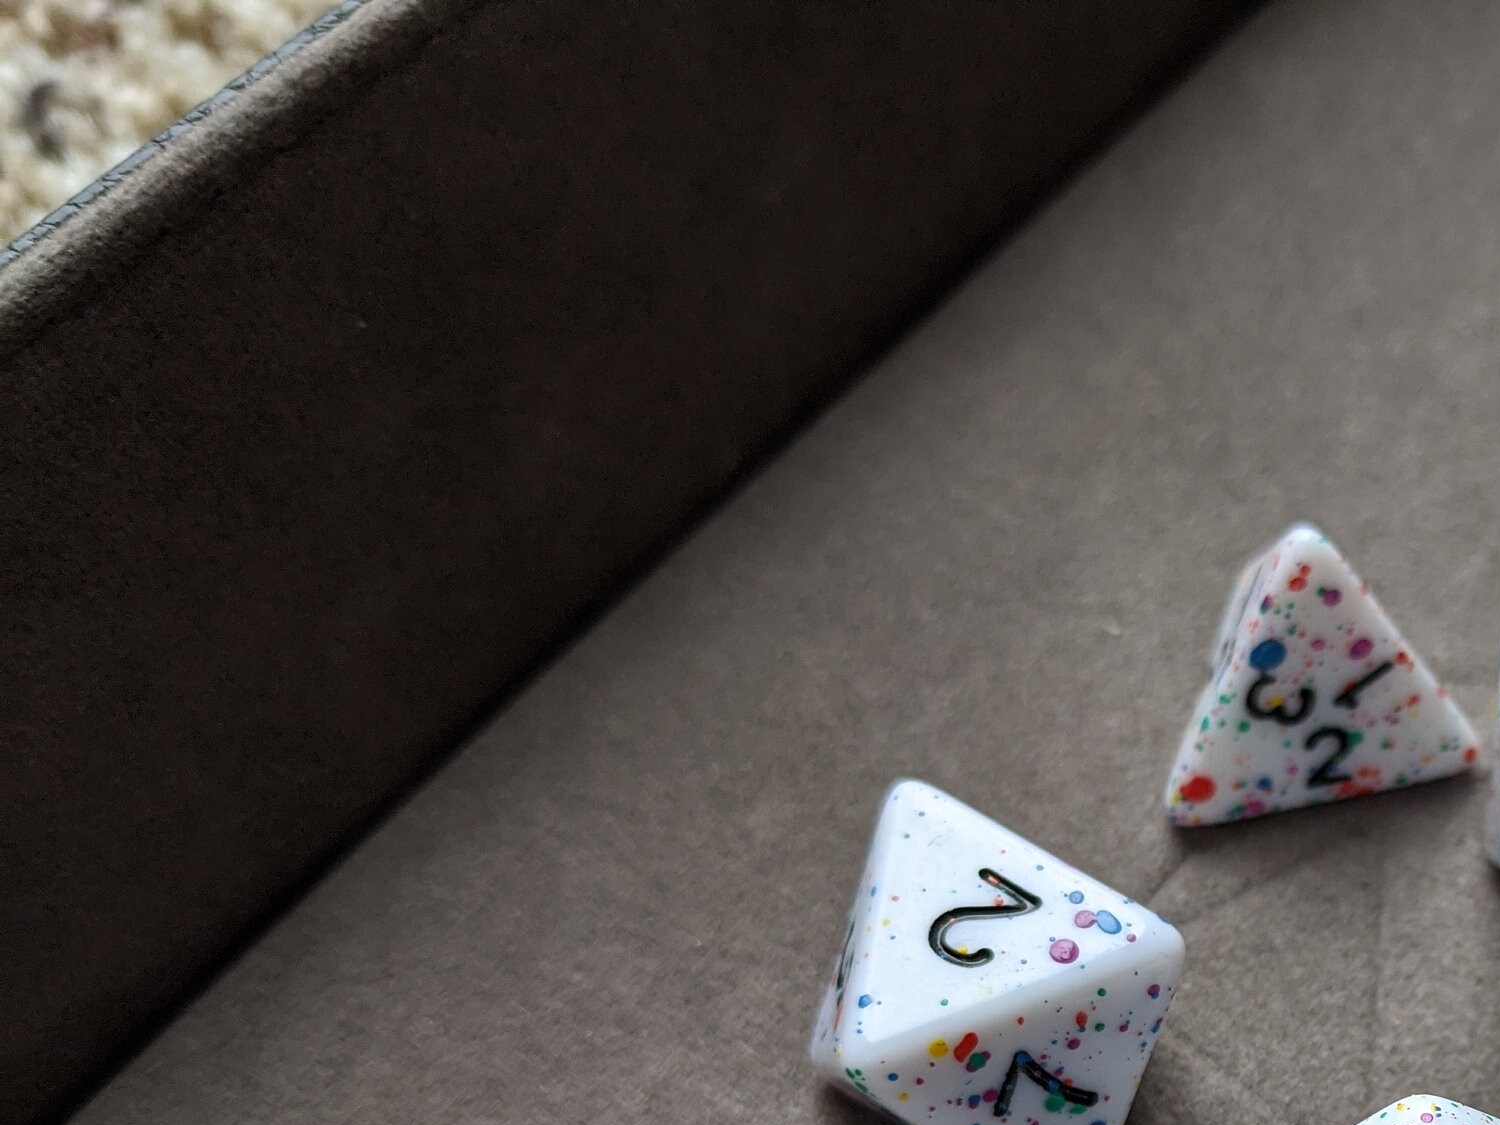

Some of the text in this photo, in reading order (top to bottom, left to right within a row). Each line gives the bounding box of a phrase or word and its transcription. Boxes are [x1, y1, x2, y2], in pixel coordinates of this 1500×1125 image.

[1245, 675, 1316, 726] 3
[1335, 661, 1394, 708] 1
[1305, 727, 1353, 788] 2
[928, 868, 1043, 969] 2
[993, 1050, 1099, 1117] 7
